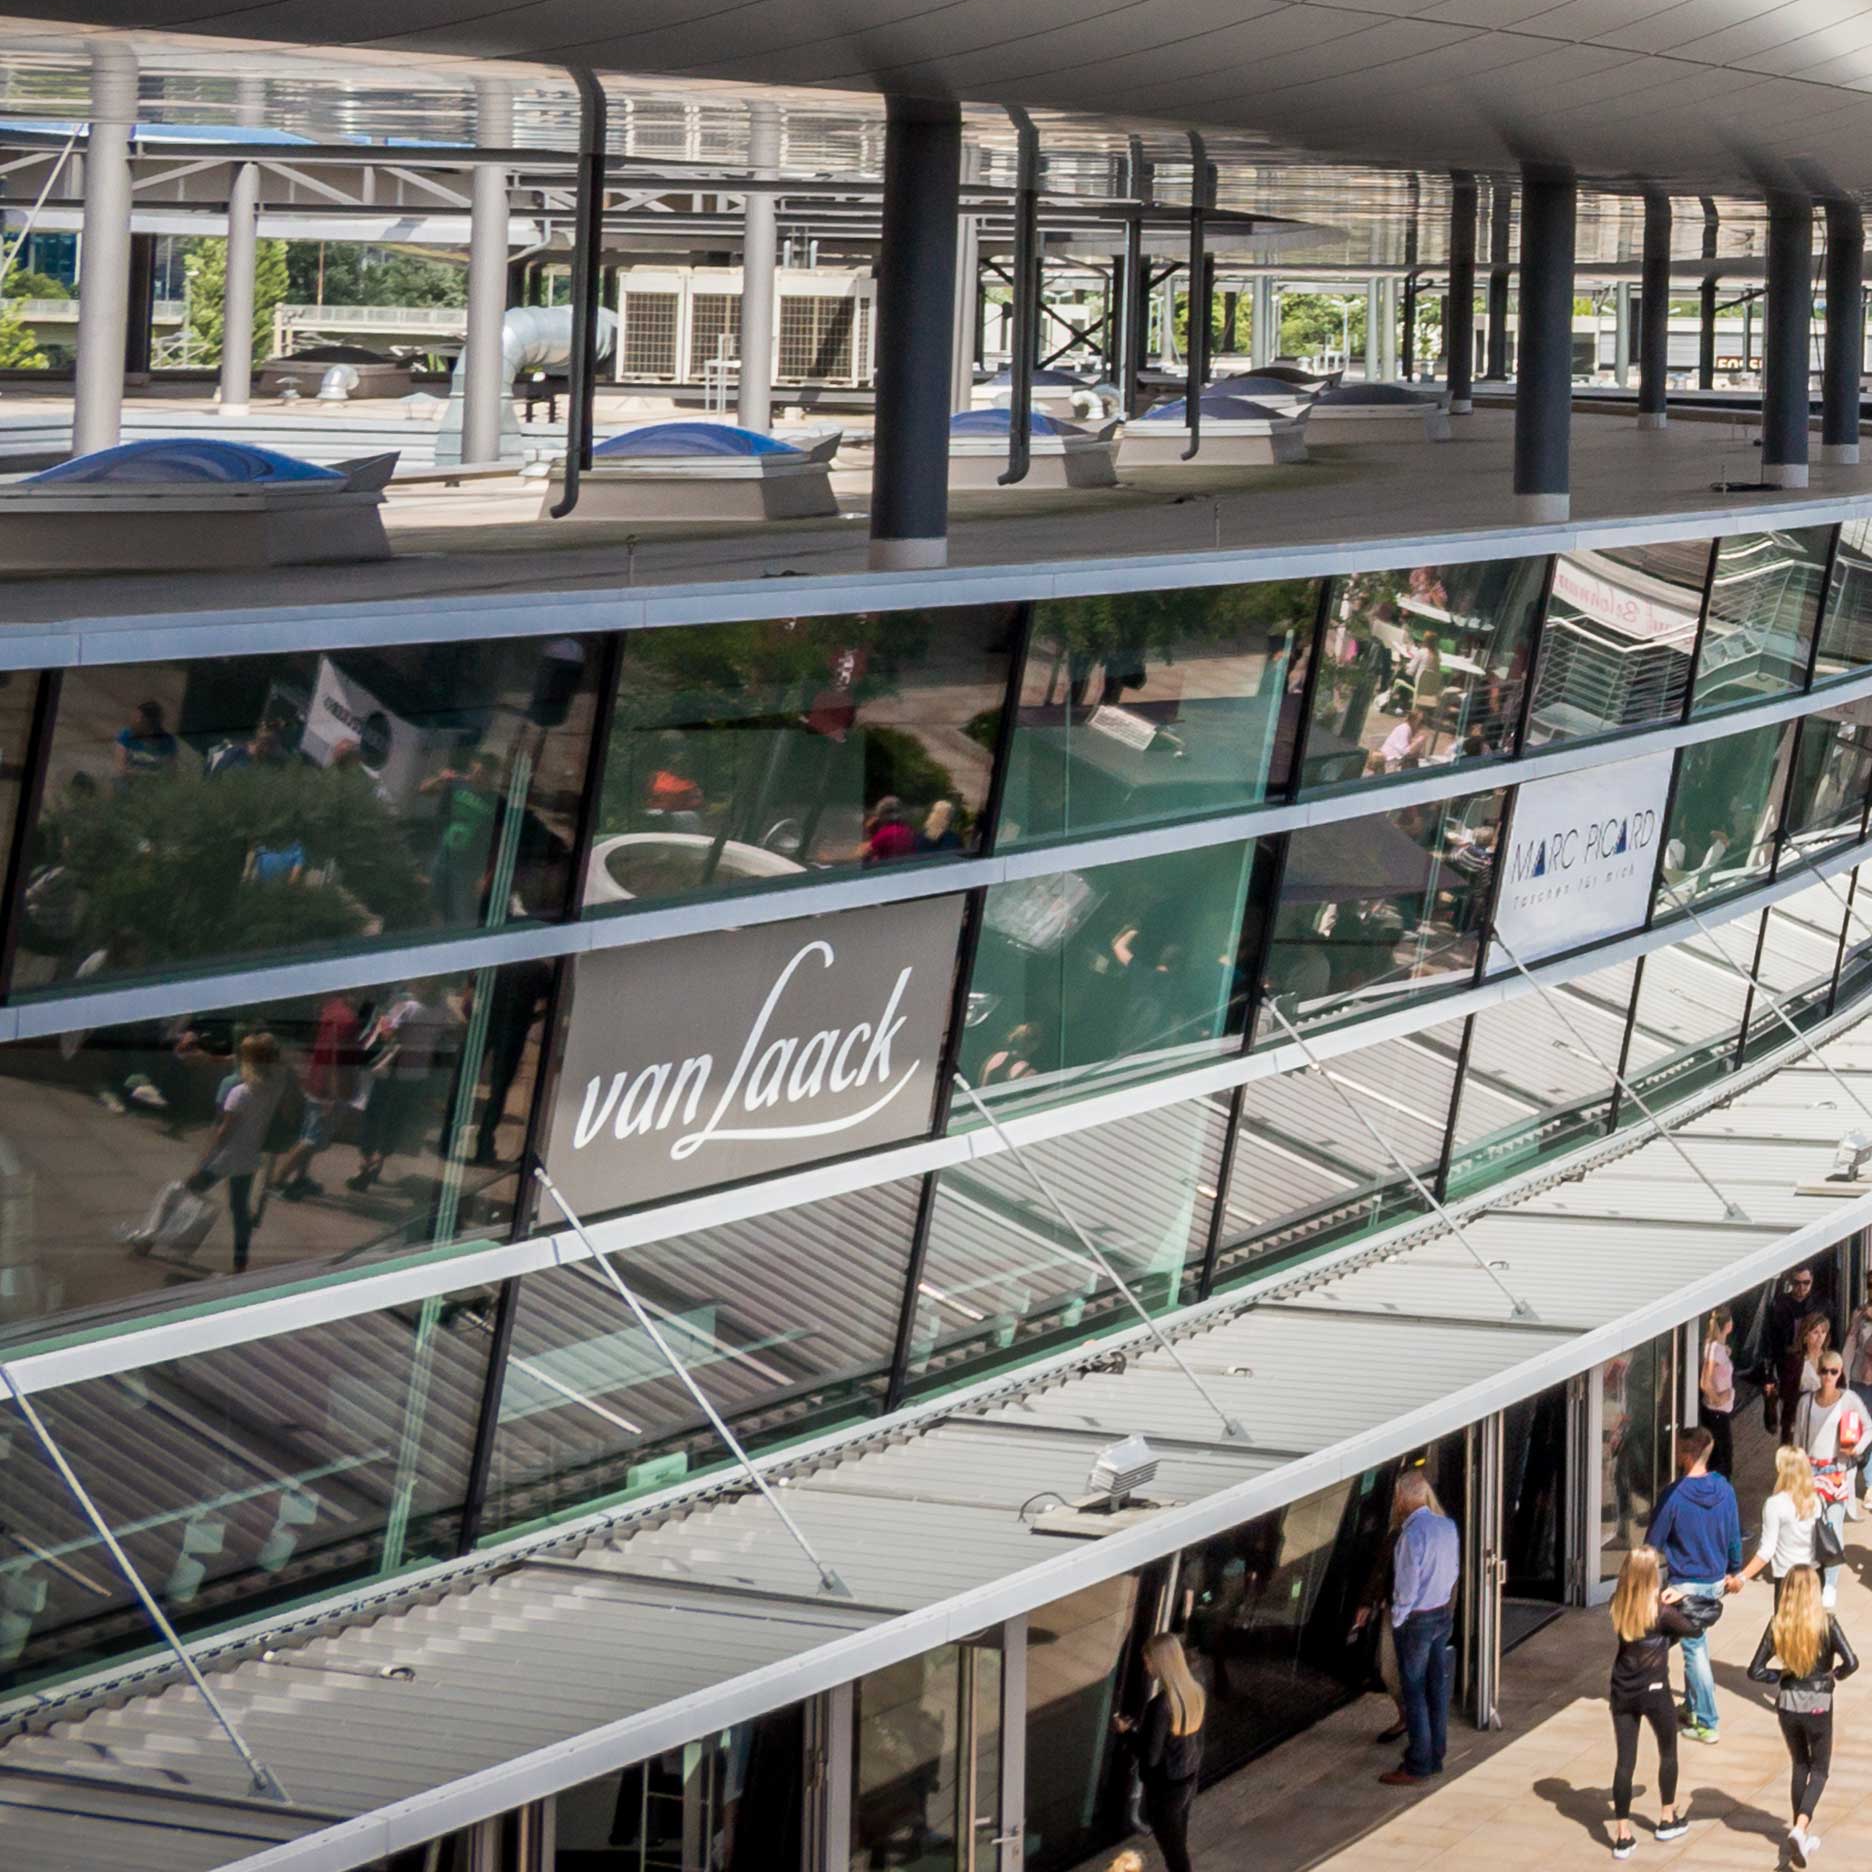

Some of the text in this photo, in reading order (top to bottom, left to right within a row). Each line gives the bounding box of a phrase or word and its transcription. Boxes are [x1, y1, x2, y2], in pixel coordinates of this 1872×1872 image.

[1510, 808, 1656, 884] MARC PICARD
[574, 940, 921, 1161] van Laack
